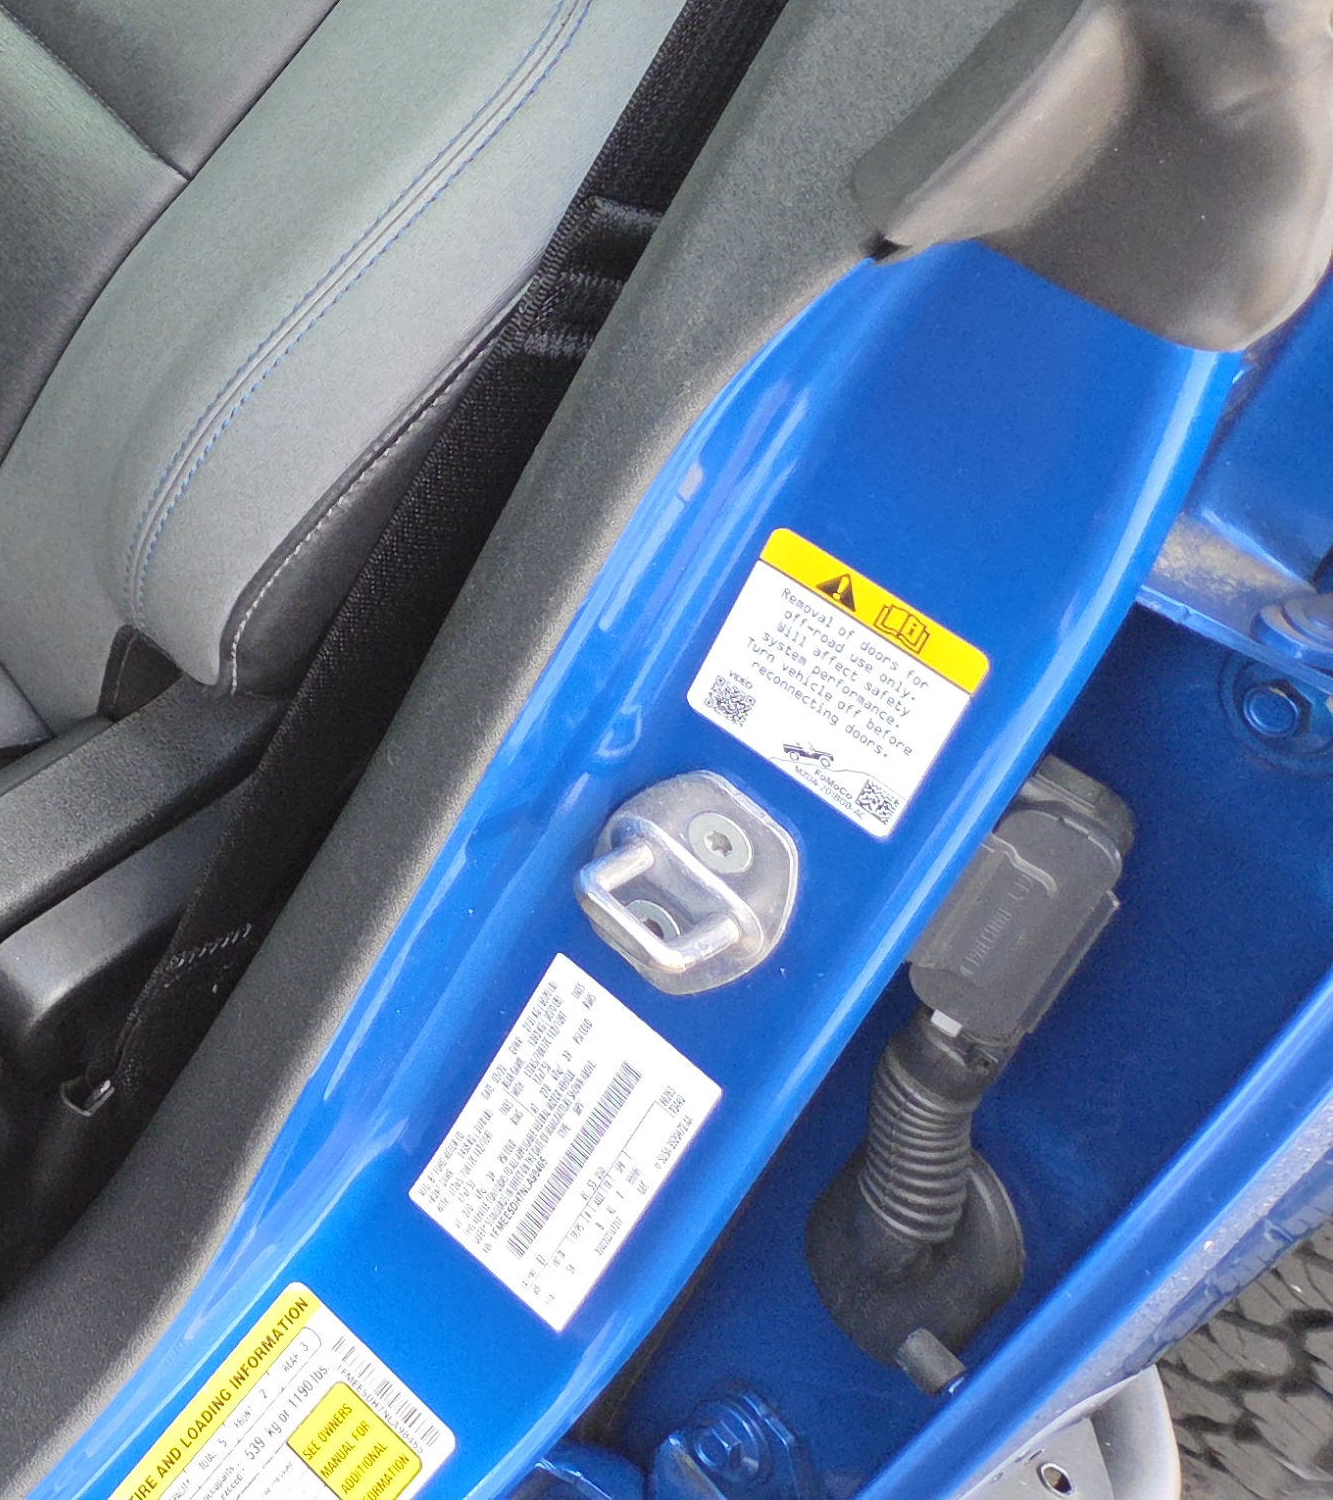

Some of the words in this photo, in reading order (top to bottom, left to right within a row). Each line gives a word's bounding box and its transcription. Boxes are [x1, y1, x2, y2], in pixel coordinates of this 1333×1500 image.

[727, 668, 753, 690] VIDEO
[760, 630, 808, 669] system
[810, 663, 903, 730] performance.
[775, 620, 808, 648] Will
[811, 644, 860, 682] affect
[861, 679, 912, 719] safety
[779, 586, 835, 628] Removal
[837, 624, 855, 642] of
[858, 638, 901, 672] doors
[904, 668, 931, 691] for
[782, 607, 846, 654] off-road
[848, 653, 874, 674] use
[876, 670, 919, 705] only.
[744, 635, 777, 664] Turn
[779, 660, 834, 702] vehicle
[836, 697, 861, 720] off
[864, 717, 915, 757] before
[749, 658, 841, 727] reconnecting
[843, 722, 891, 759] doors.
[813, 768, 854, 801] FoMoCo
[153, 1444, 183, 1479] AND
[178, 1386, 232, 1449] LOADING
[228, 1294, 309, 1390] INFORMATION
[216, 1435, 228, 1448] 5
[258, 1387, 269, 1399] 2
[298, 1340, 309, 1352] 3
[243, 1434, 266, 1461] 539
[263, 1418, 283, 1440] kg
[277, 1408, 290, 1423] or
[286, 1377, 315, 1409] 1190
[308, 1359, 330, 1384] lbs.
[301, 1438, 321, 1461] SEE
[316, 1400, 353, 1444] OWNERS
[318, 1436, 356, 1480] MANUAL
[350, 1418, 371, 1442] FOR
[338, 1437, 388, 1495] ADDITIONAL
